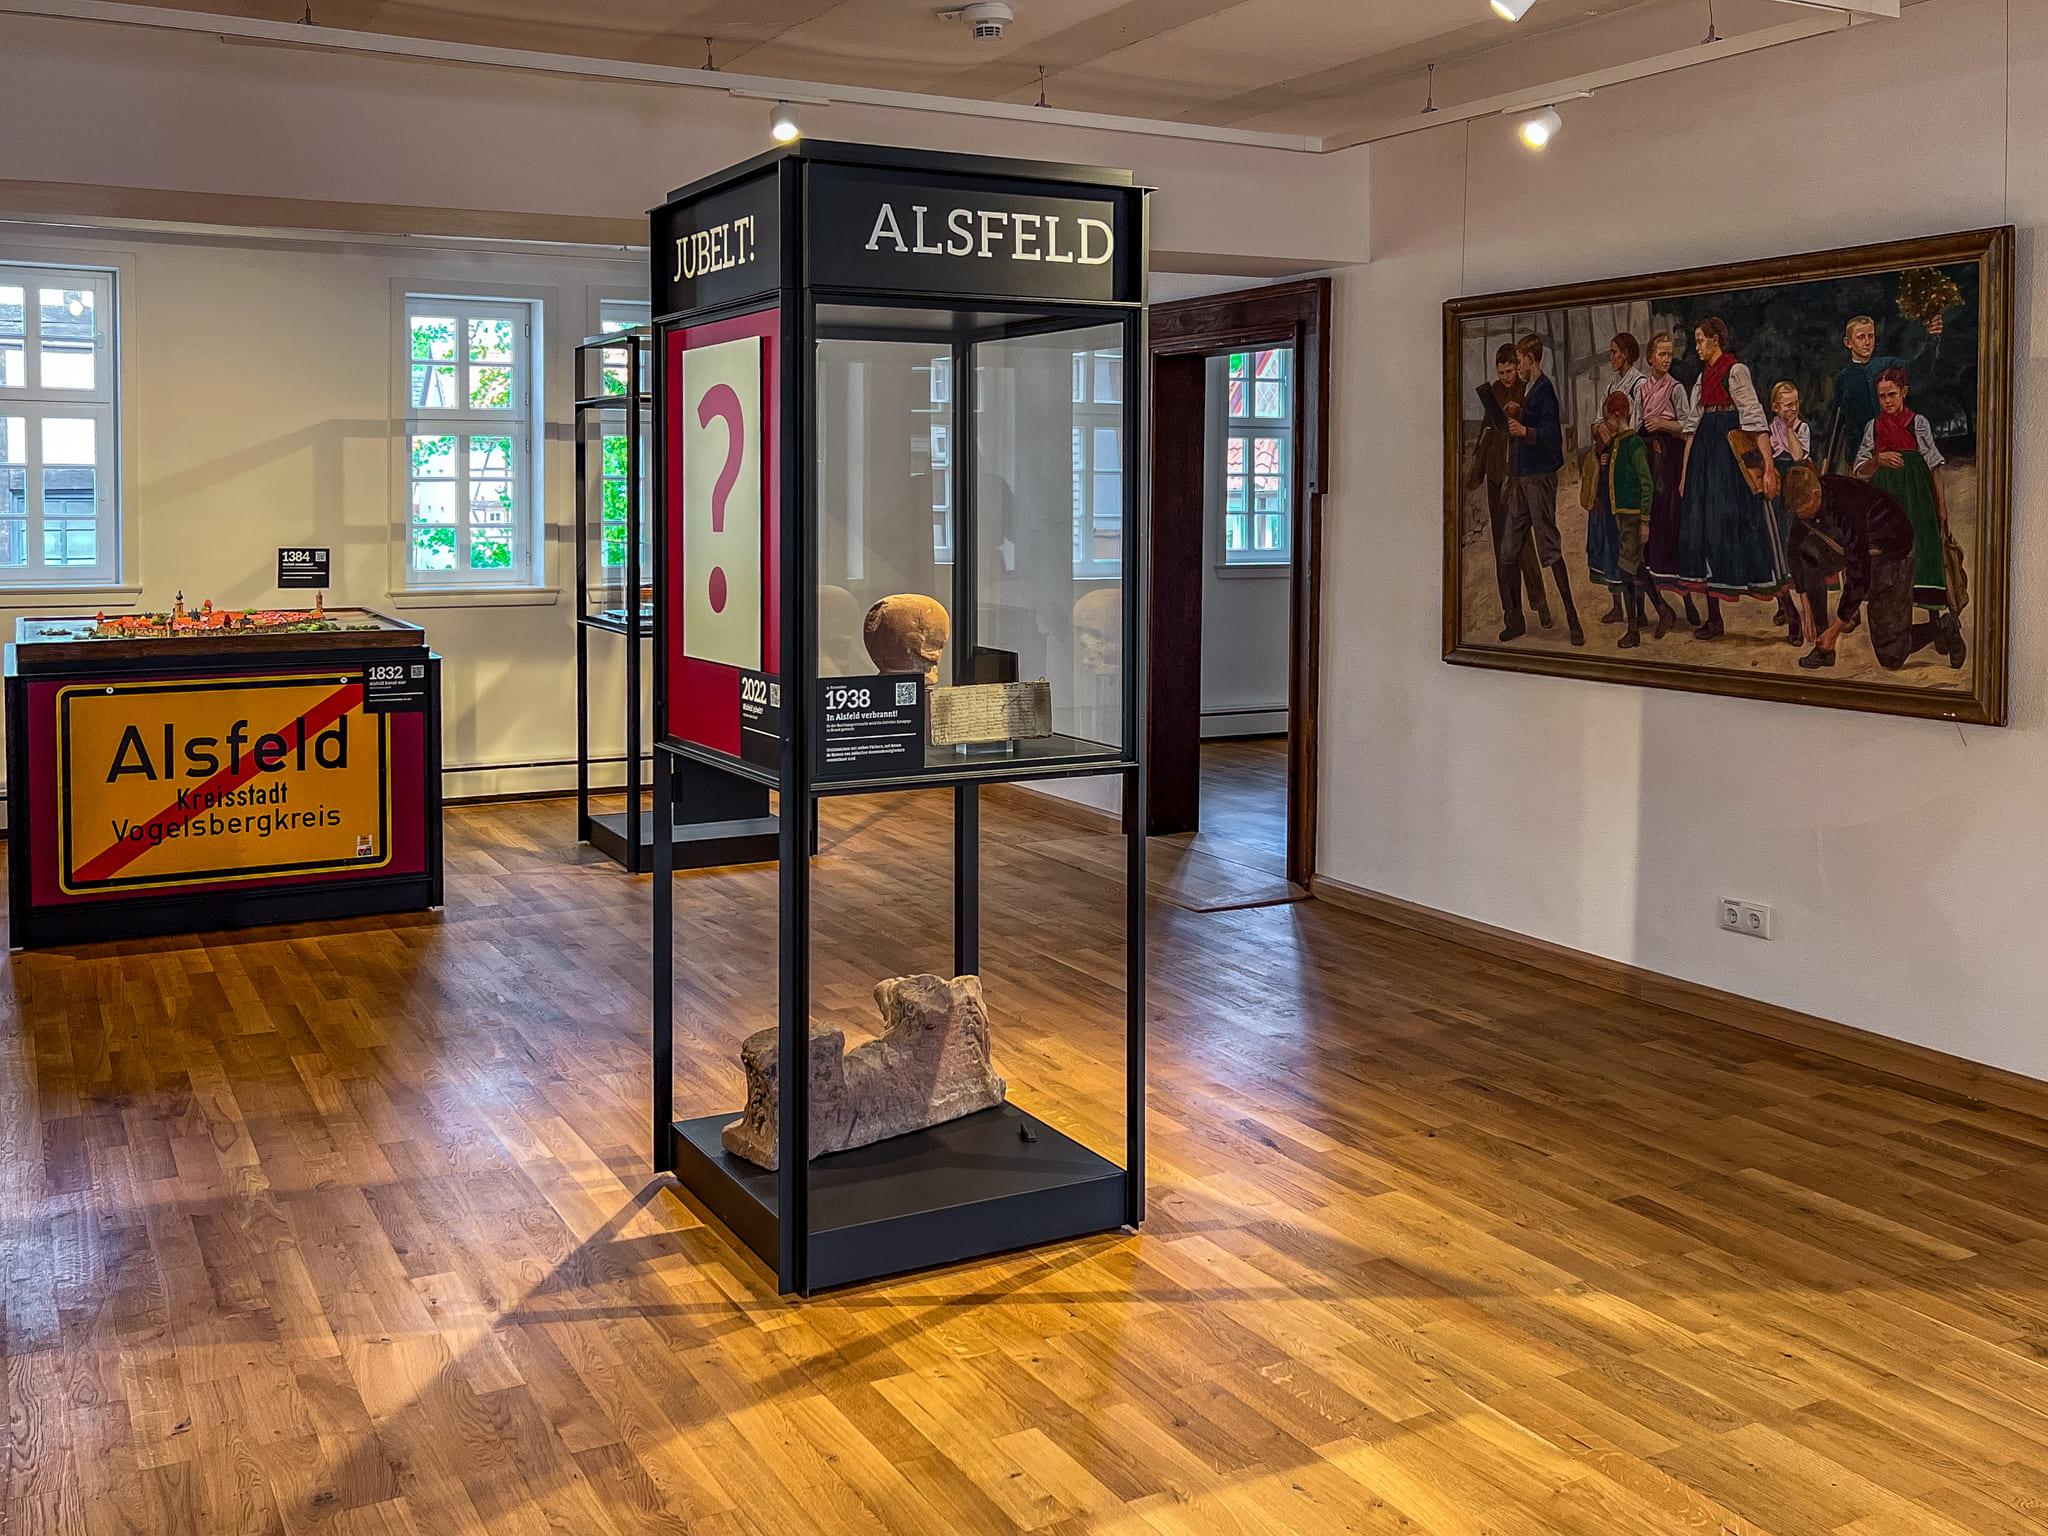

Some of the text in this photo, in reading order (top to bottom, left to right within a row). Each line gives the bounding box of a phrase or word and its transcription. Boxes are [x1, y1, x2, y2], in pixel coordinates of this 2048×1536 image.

[673, 214, 755, 282] JUBELT!
[865, 203, 1115, 265] ALSFELD
[282, 551, 310, 562] 1384
[369, 666, 404, 680] 1832
[741, 676, 767, 705] 2022
[825, 688, 871, 710] 1938
[826, 710, 898, 722] In Alsfeld verbrannt!
[106, 714, 348, 783] Alsfeld
[177, 781, 288, 811] Kreisstadt
[112, 804, 341, 846] Vogelsbergkreis
